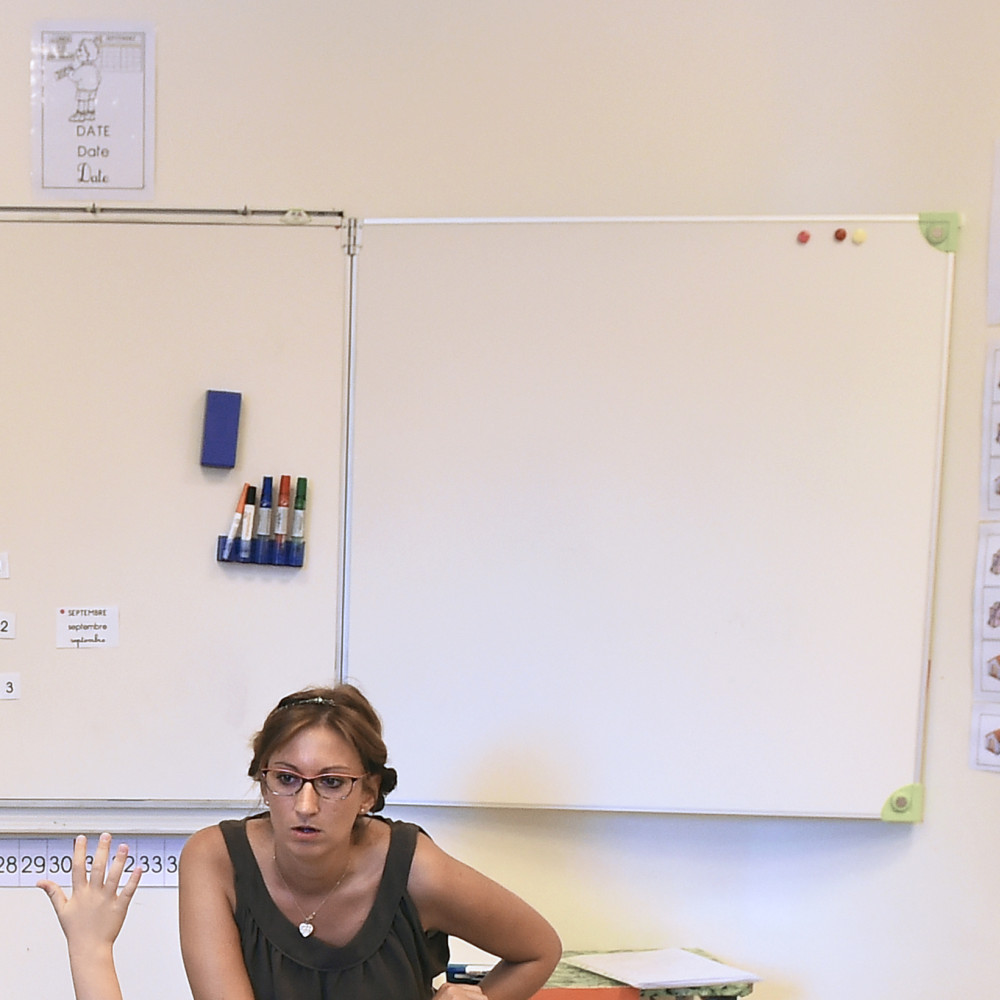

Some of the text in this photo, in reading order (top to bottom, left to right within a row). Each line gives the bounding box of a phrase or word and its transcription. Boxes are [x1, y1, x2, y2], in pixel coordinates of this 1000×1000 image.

[77, 125, 110, 137] DATE
[77, 146, 110, 158] Date
[77, 162, 110, 184] Date
[0, 620, 9, 633] 2
[68, 622, 107, 631] septembre
[5, 681, 14, 694] 3
[21, 855, 46, 874] 29
[49, 855, 72, 873] 30
[140, 855, 162, 873] 33
